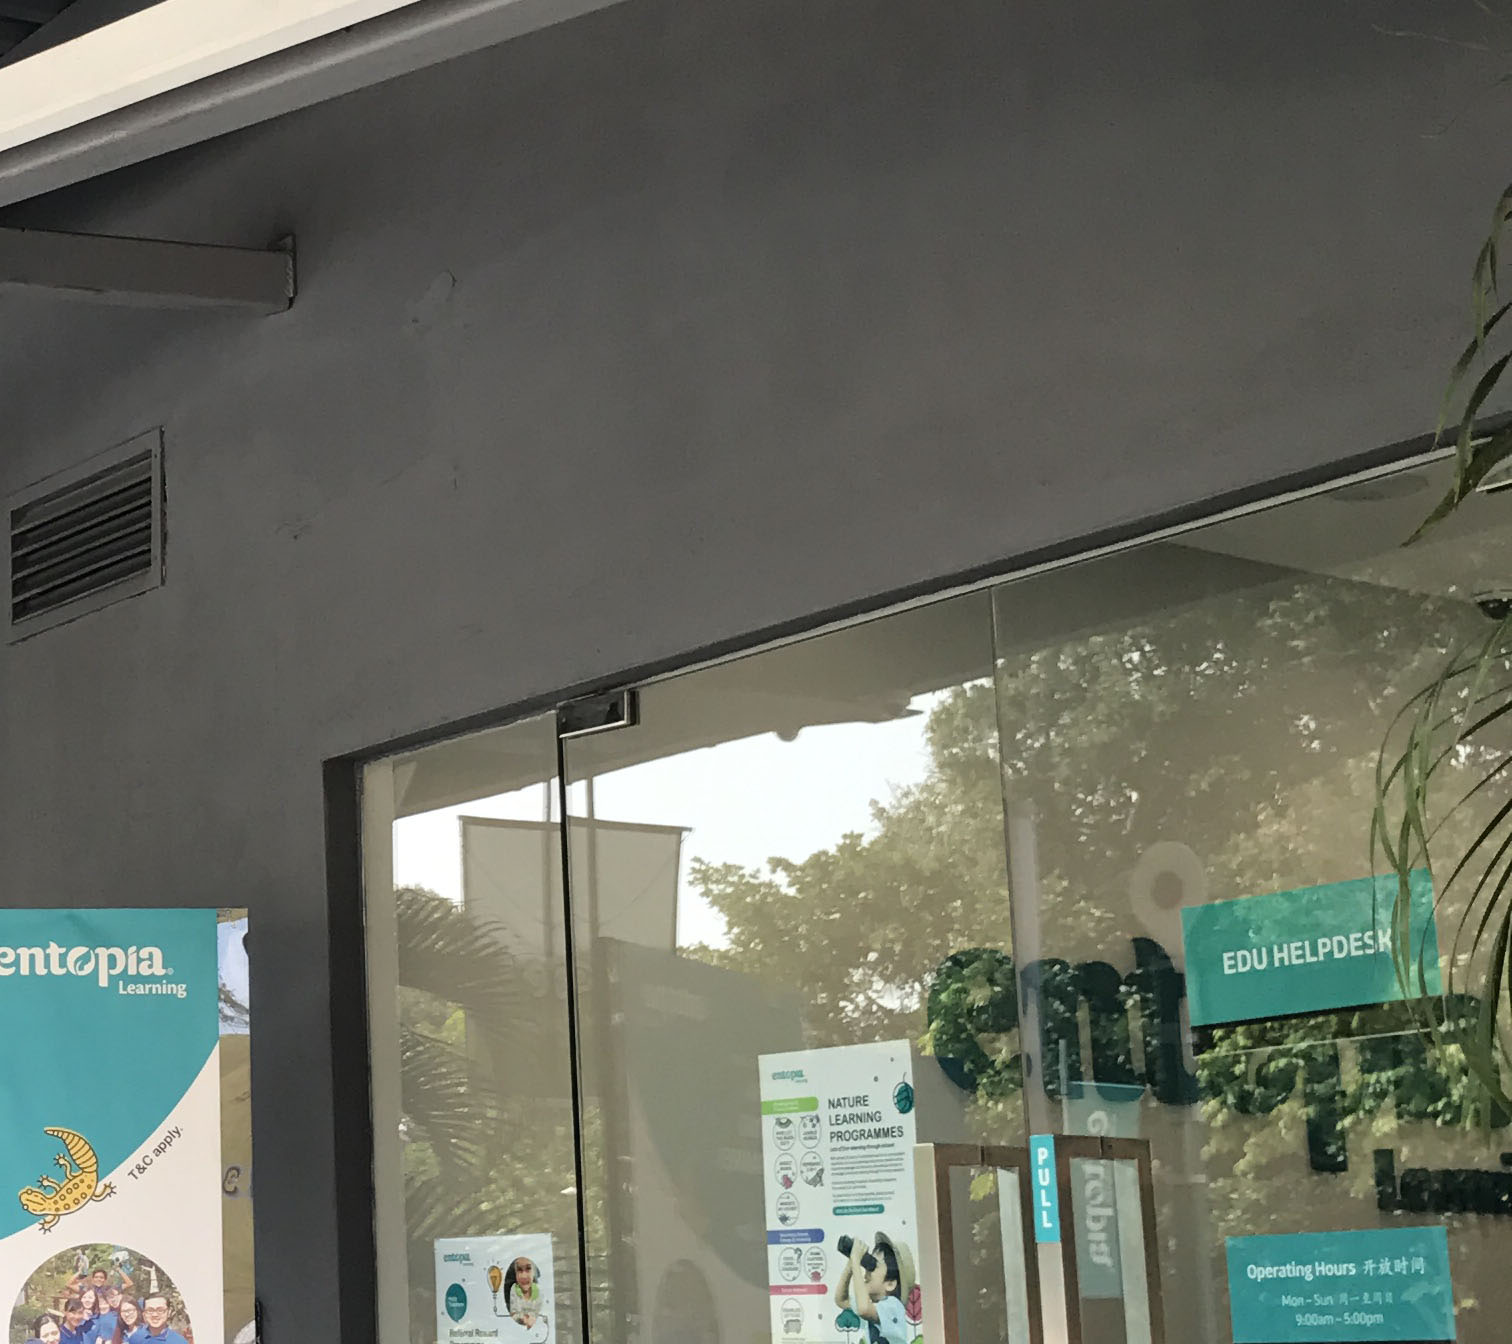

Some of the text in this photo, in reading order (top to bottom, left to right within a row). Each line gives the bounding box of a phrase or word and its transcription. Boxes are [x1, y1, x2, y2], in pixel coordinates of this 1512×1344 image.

[1223, 928, 1393, 975] EDU HELPDESK
[118, 979, 187, 998] Learning
[828, 1095, 869, 1109] NATURE
[828, 1111, 882, 1127] LEARNING
[830, 1126, 904, 1143] PROGRAMMES
[128, 1125, 184, 1182] T&C apply.
[1037, 1147, 1053, 1229] PULL
[1246, 1261, 1314, 1282] Operating
[1315, 1261, 1357, 1276] Hours
[1281, 1294, 1304, 1307] Mon
[1314, 1294, 1334, 1306] Sun
[1295, 1313, 1334, 1326] 9:00am
[1344, 1312, 1384, 1327] 5:00pm
